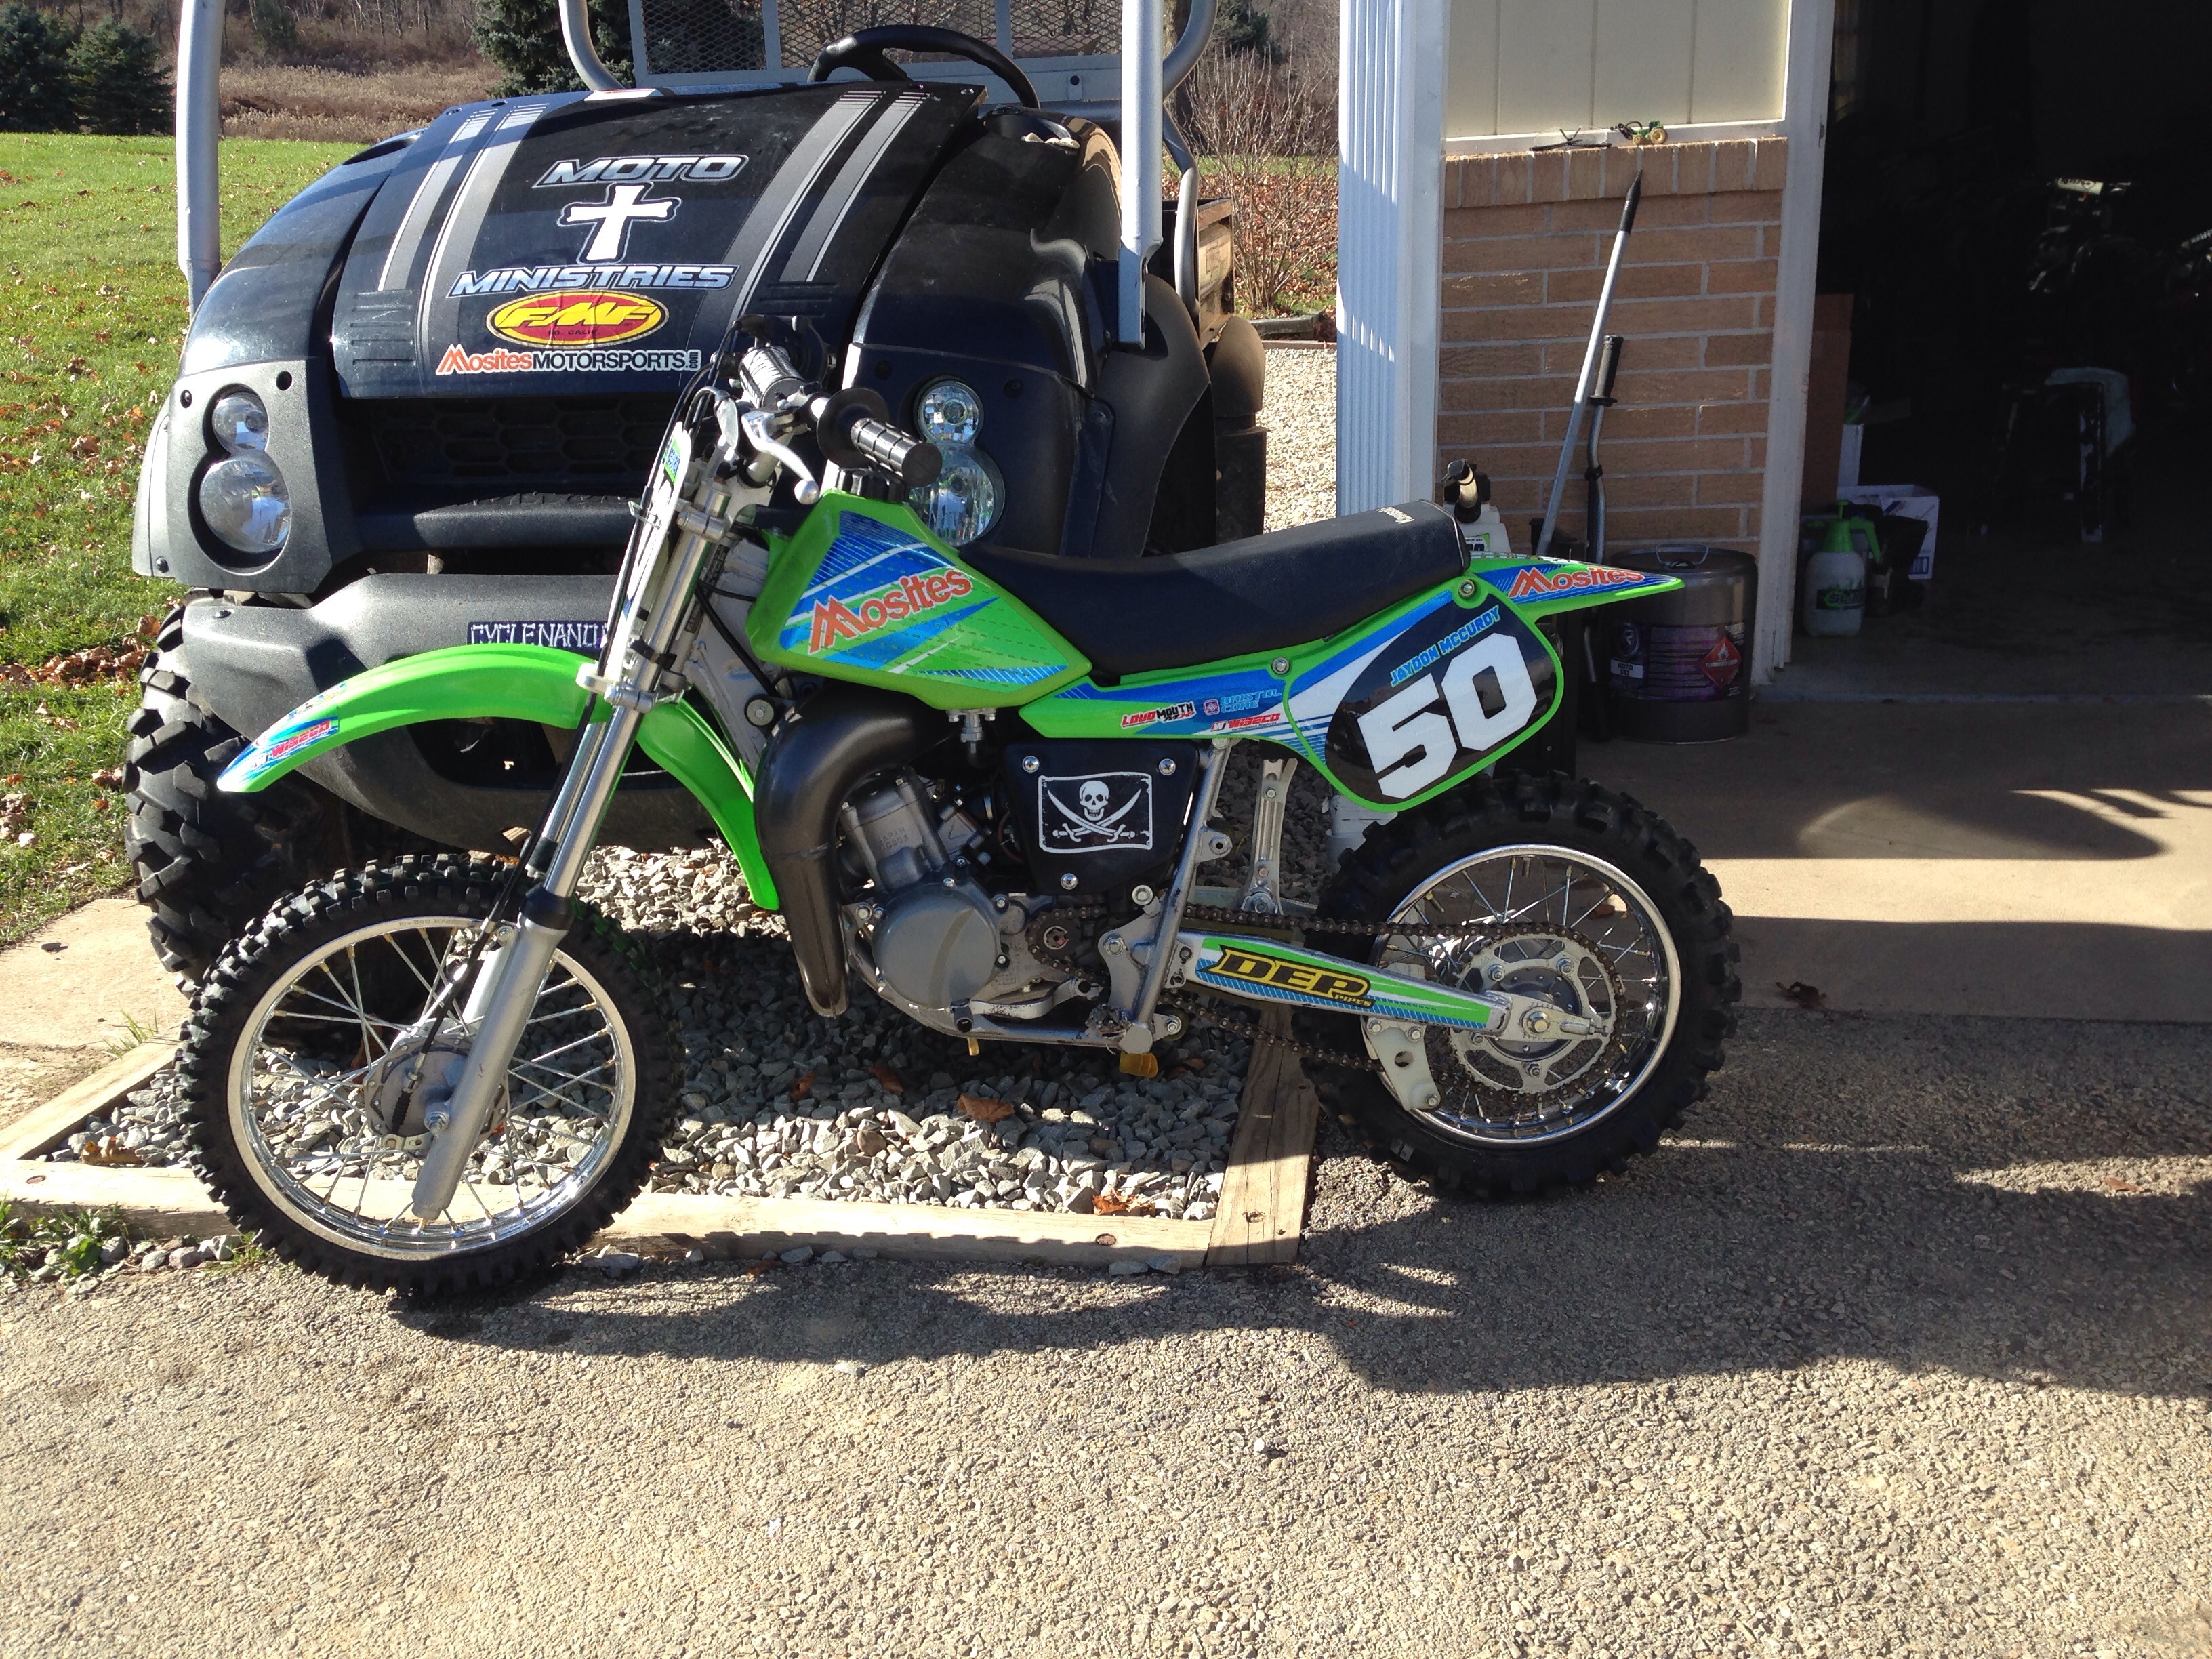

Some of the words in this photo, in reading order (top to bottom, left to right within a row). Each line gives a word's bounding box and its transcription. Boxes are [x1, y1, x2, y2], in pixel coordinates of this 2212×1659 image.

[538, 155, 748, 186] MOTO
[447, 265, 739, 297] MINISTRIES
[497, 302, 661, 329] FMF
[1508, 567, 1645, 598] Mosites
[808, 571, 972, 654] Mosites
[1391, 644, 1441, 687] JAYDON
[1437, 605, 1501, 655] MCCURDY
[1220, 689, 1282, 705] BRISTOL
[1221, 699, 1259, 713] CORE
[1229, 713, 1281, 729] WISECO
[1357, 632, 1537, 799] 50
[272, 719, 331, 758] WISECO
[1214, 952, 1368, 998] DEP
[1334, 994, 1372, 1006] PIPES
